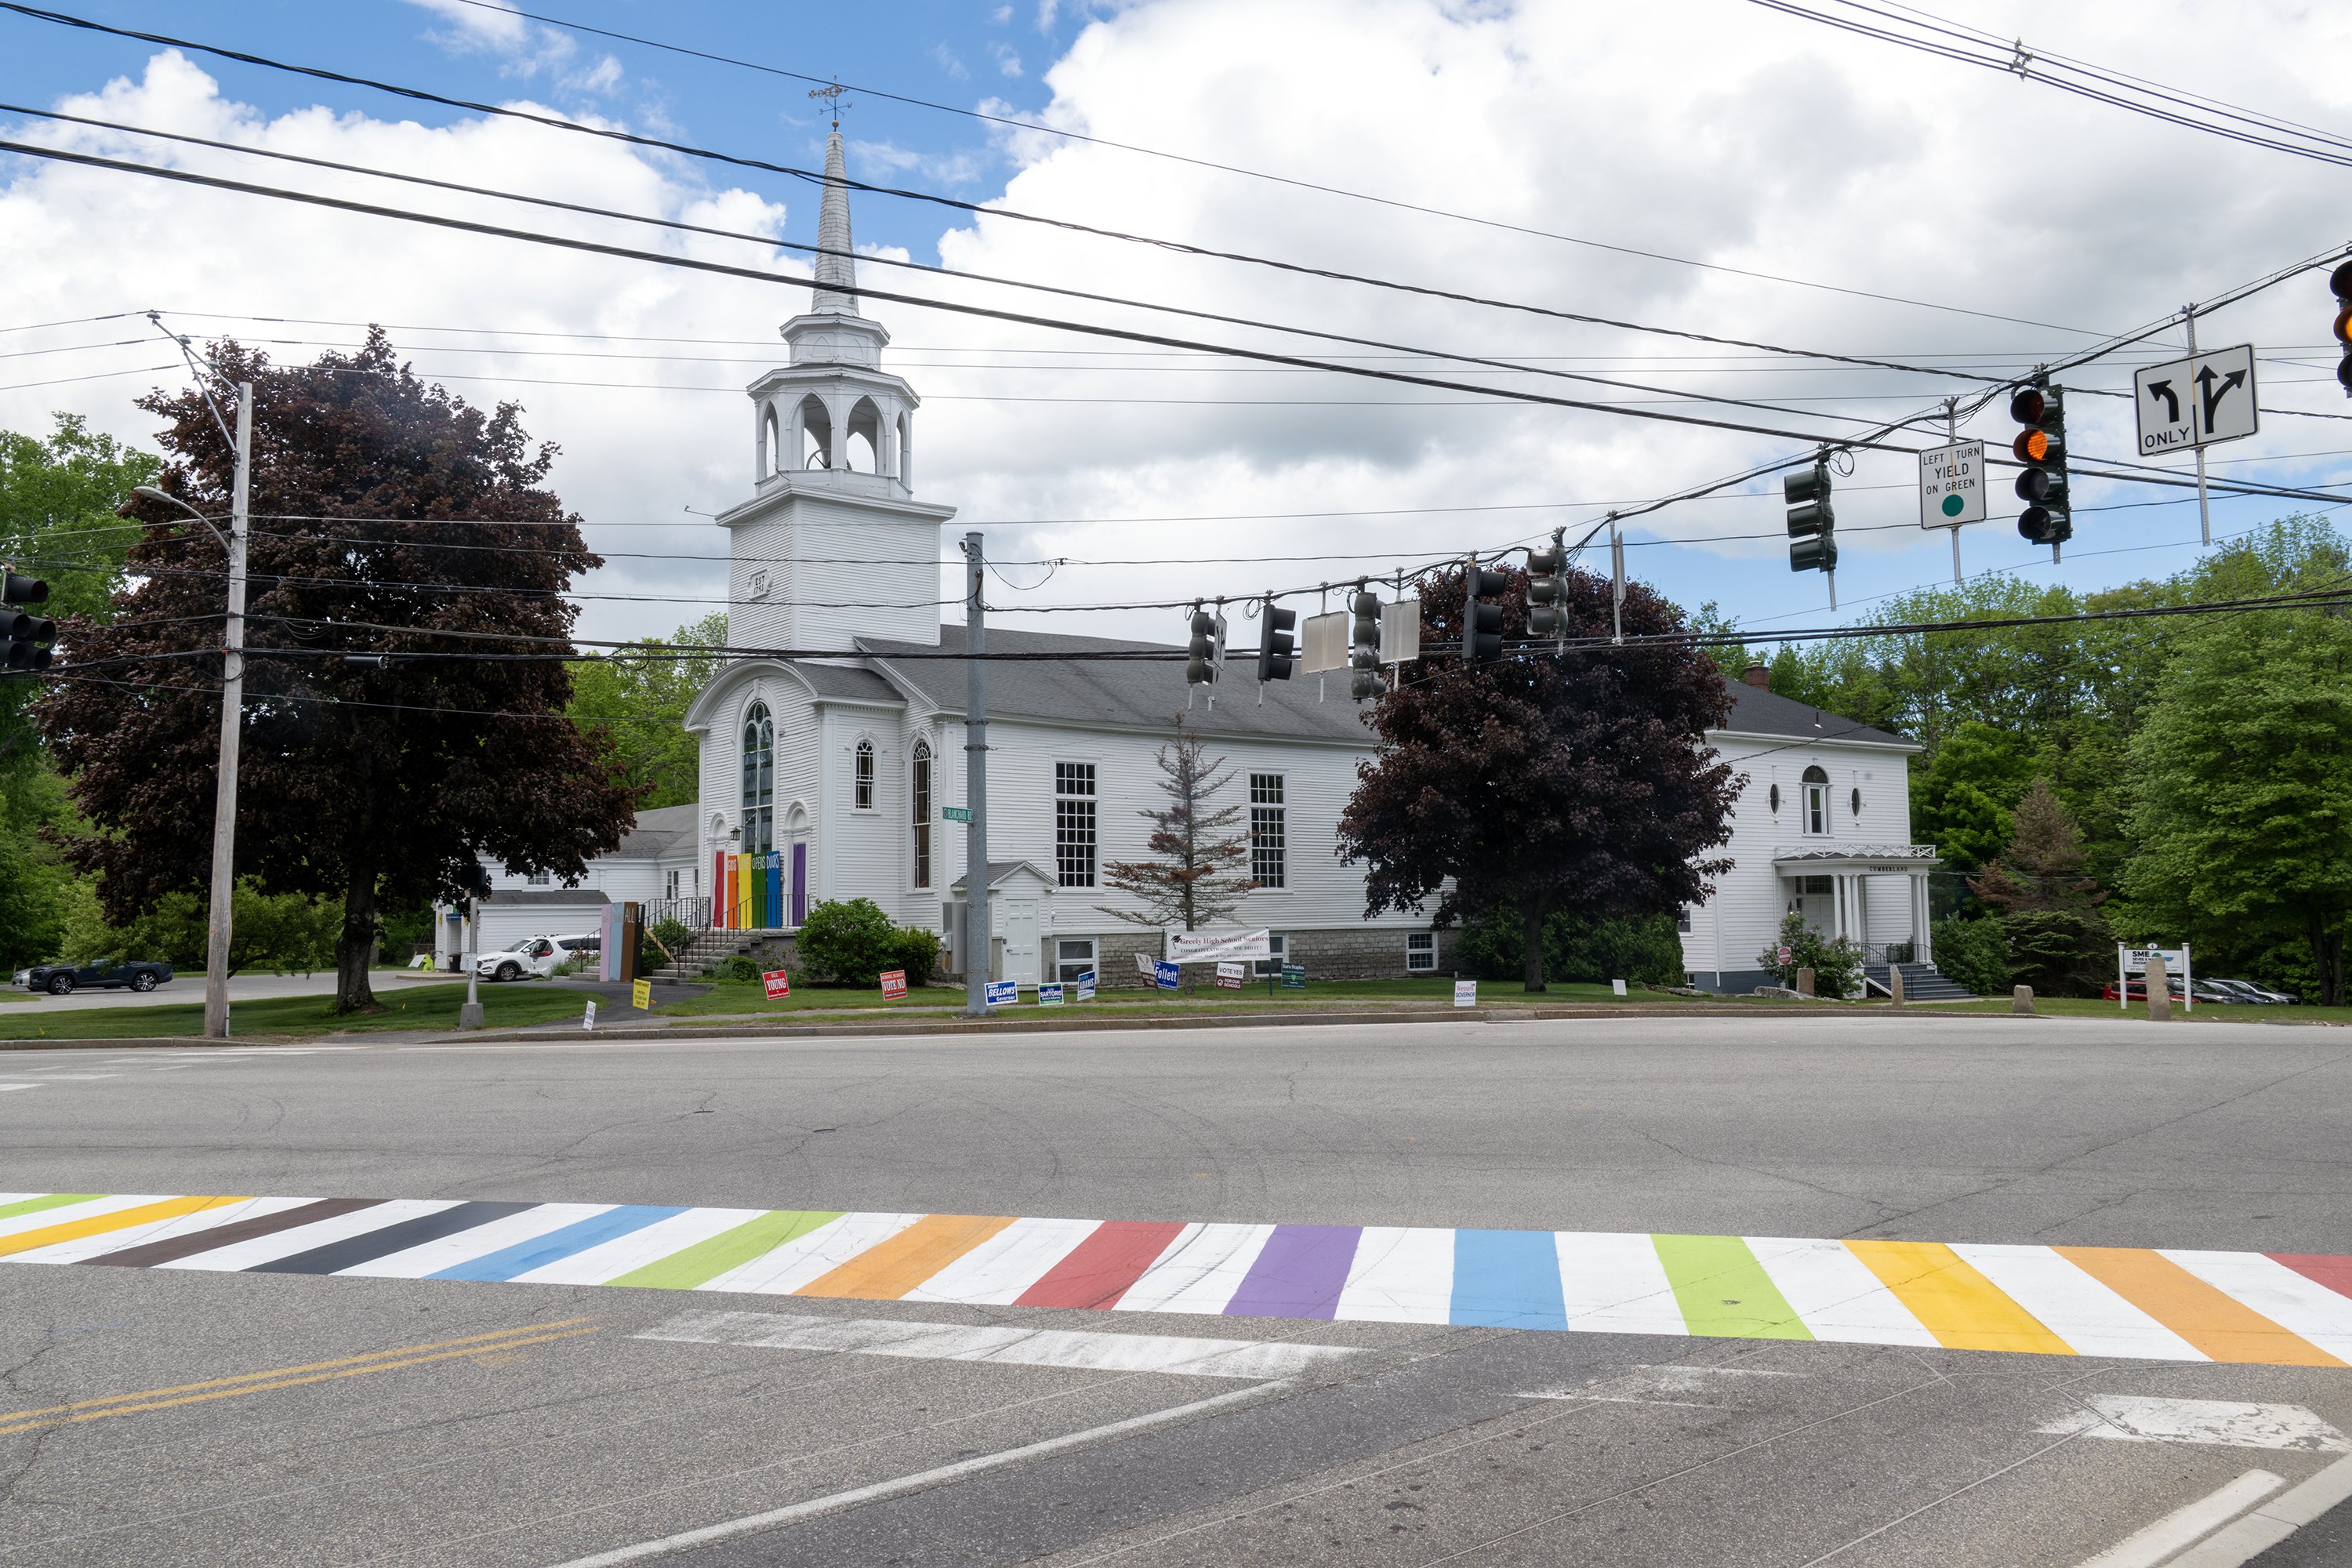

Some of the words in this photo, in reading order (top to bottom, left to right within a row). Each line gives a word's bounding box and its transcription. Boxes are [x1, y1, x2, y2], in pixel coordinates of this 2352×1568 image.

[2144, 426, 2190, 448] ONLY
[1923, 453, 1944, 466] LEFT
[1955, 447, 1980, 459] TURN
[1935, 463, 1969, 479] YIELD
[1926, 485, 1938, 495] ON
[1945, 478, 1975, 492] GREEN
[755, 575, 765, 586] EST
[752, 856, 765, 869] OPENS
[767, 854, 779, 869] DOORS
[1155, 967, 1177, 982] Follett
[767, 978, 786, 991] YOUNG
[883, 980, 898, 992] VOTE
[898, 978, 905, 989] NO
[1080, 978, 1094, 989] ADAMS
[989, 987, 1015, 996] BELLOWS
